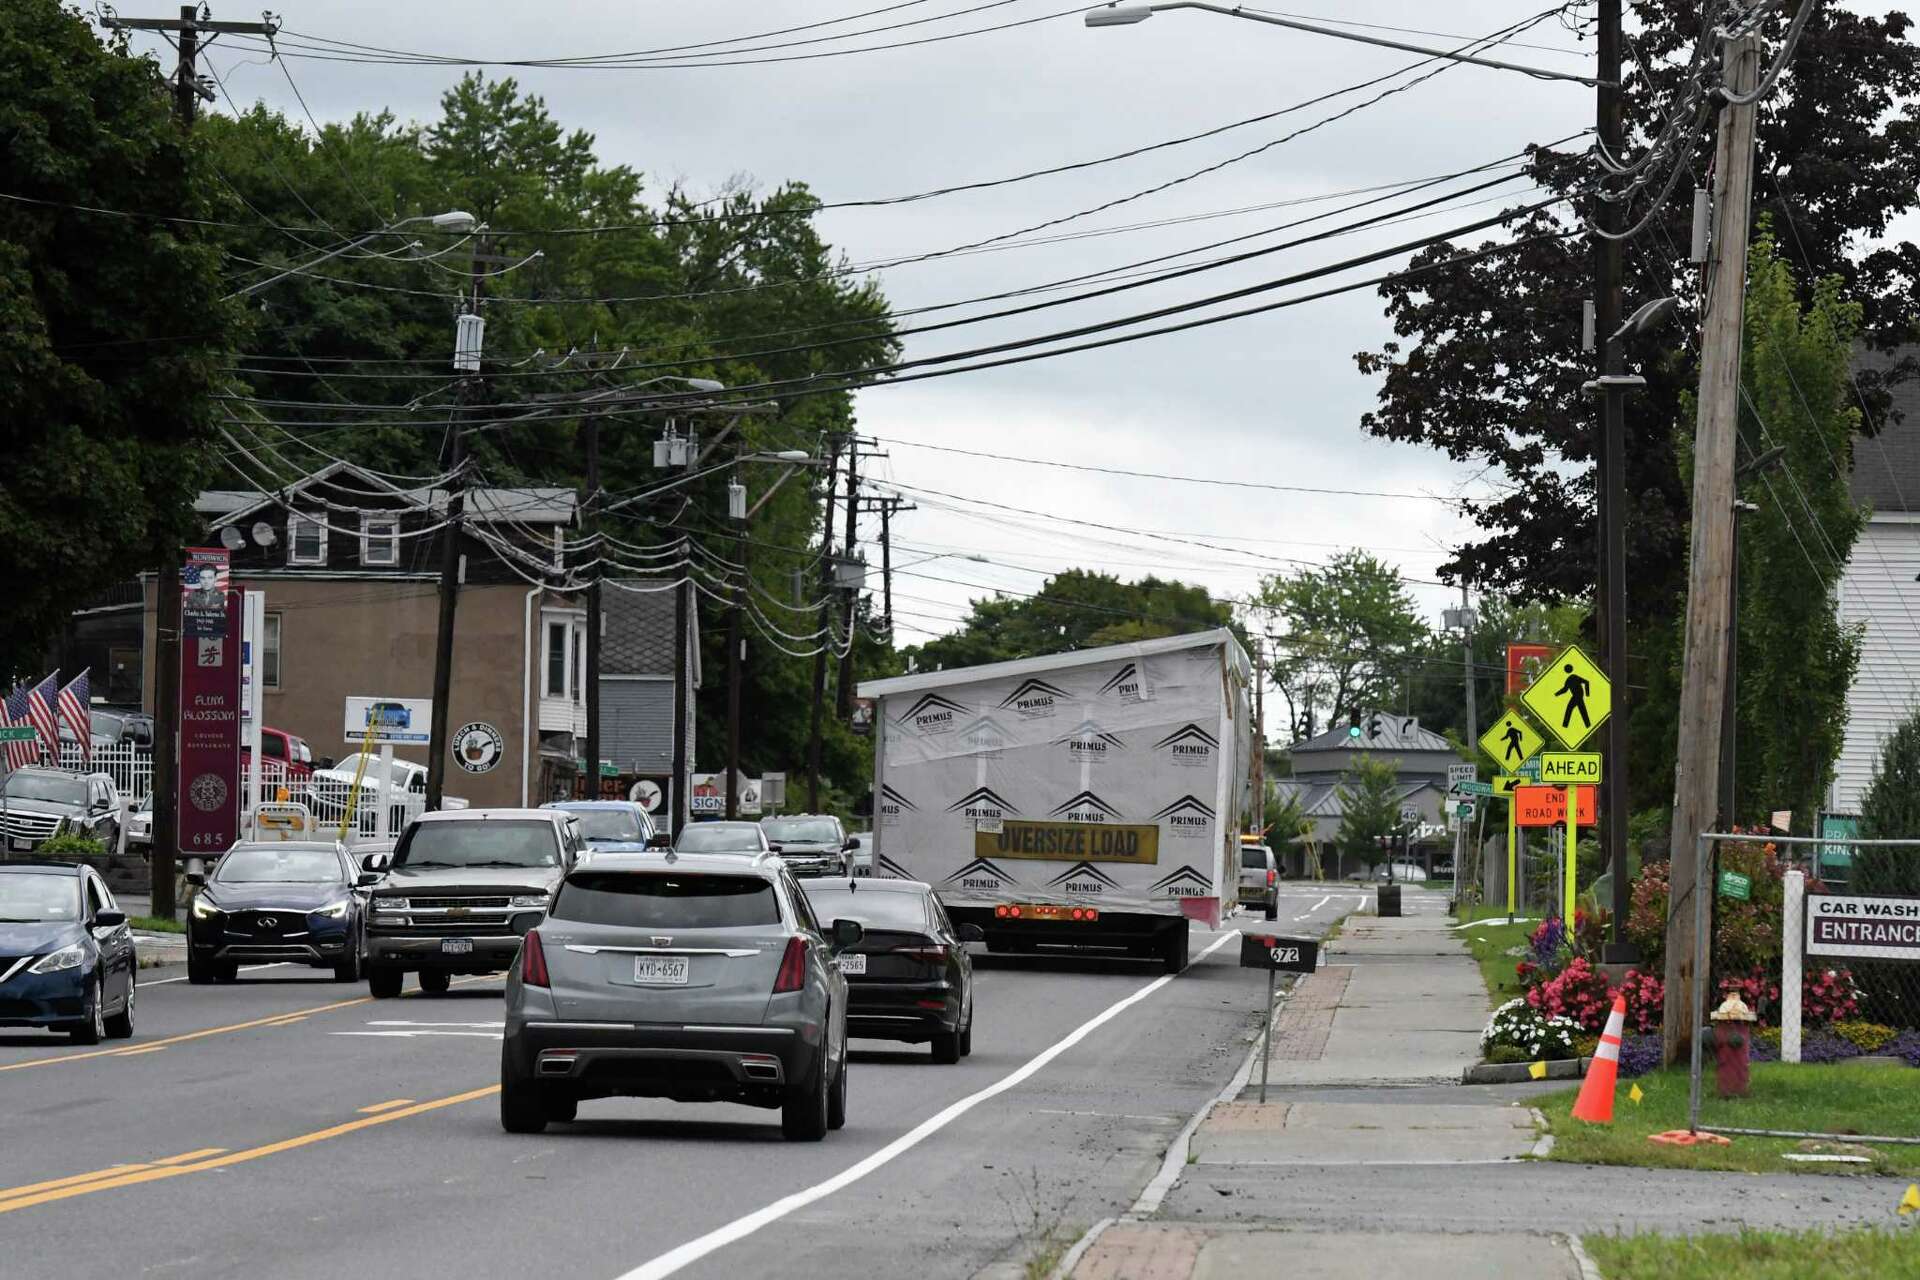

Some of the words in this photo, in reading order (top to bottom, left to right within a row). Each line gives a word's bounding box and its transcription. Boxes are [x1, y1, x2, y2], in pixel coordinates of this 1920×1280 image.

[1118, 683, 1139, 694] PRI
[195, 695, 224, 705] PLUM
[1017, 695, 1054, 709] PRIMUS
[184, 710, 235, 720] BLOSSOM
[916, 711, 952, 725] PRIMUS
[1070, 741, 1107, 751] PRIMUS
[1172, 744, 1210, 755] PRIMUS
[1545, 761, 1598, 776] AHEAD
[1545, 793, 1566, 804] END
[881, 805, 900, 814] MUS
[965, 807, 1001, 818] PRIMUS
[1525, 808, 1553, 818] ROAD
[1557, 807, 1585, 817] WK
[1068, 812, 1105, 822] PRIMUS
[1170, 815, 1207, 826] PRIMUS
[193, 832, 223, 845] 685
[997, 826, 1086, 855] OVERSIZE
[1090, 829, 1138, 856] LOAD
[963, 878, 1000, 888] PRIMUS
[1065, 882, 1103, 892] PRIMUS
[1168, 886, 1205, 897] PRIMUS
[1820, 902, 1858, 914] CAR
[1864, 904, 1918, 917] WASH
[1272, 948, 1298, 961] 672
